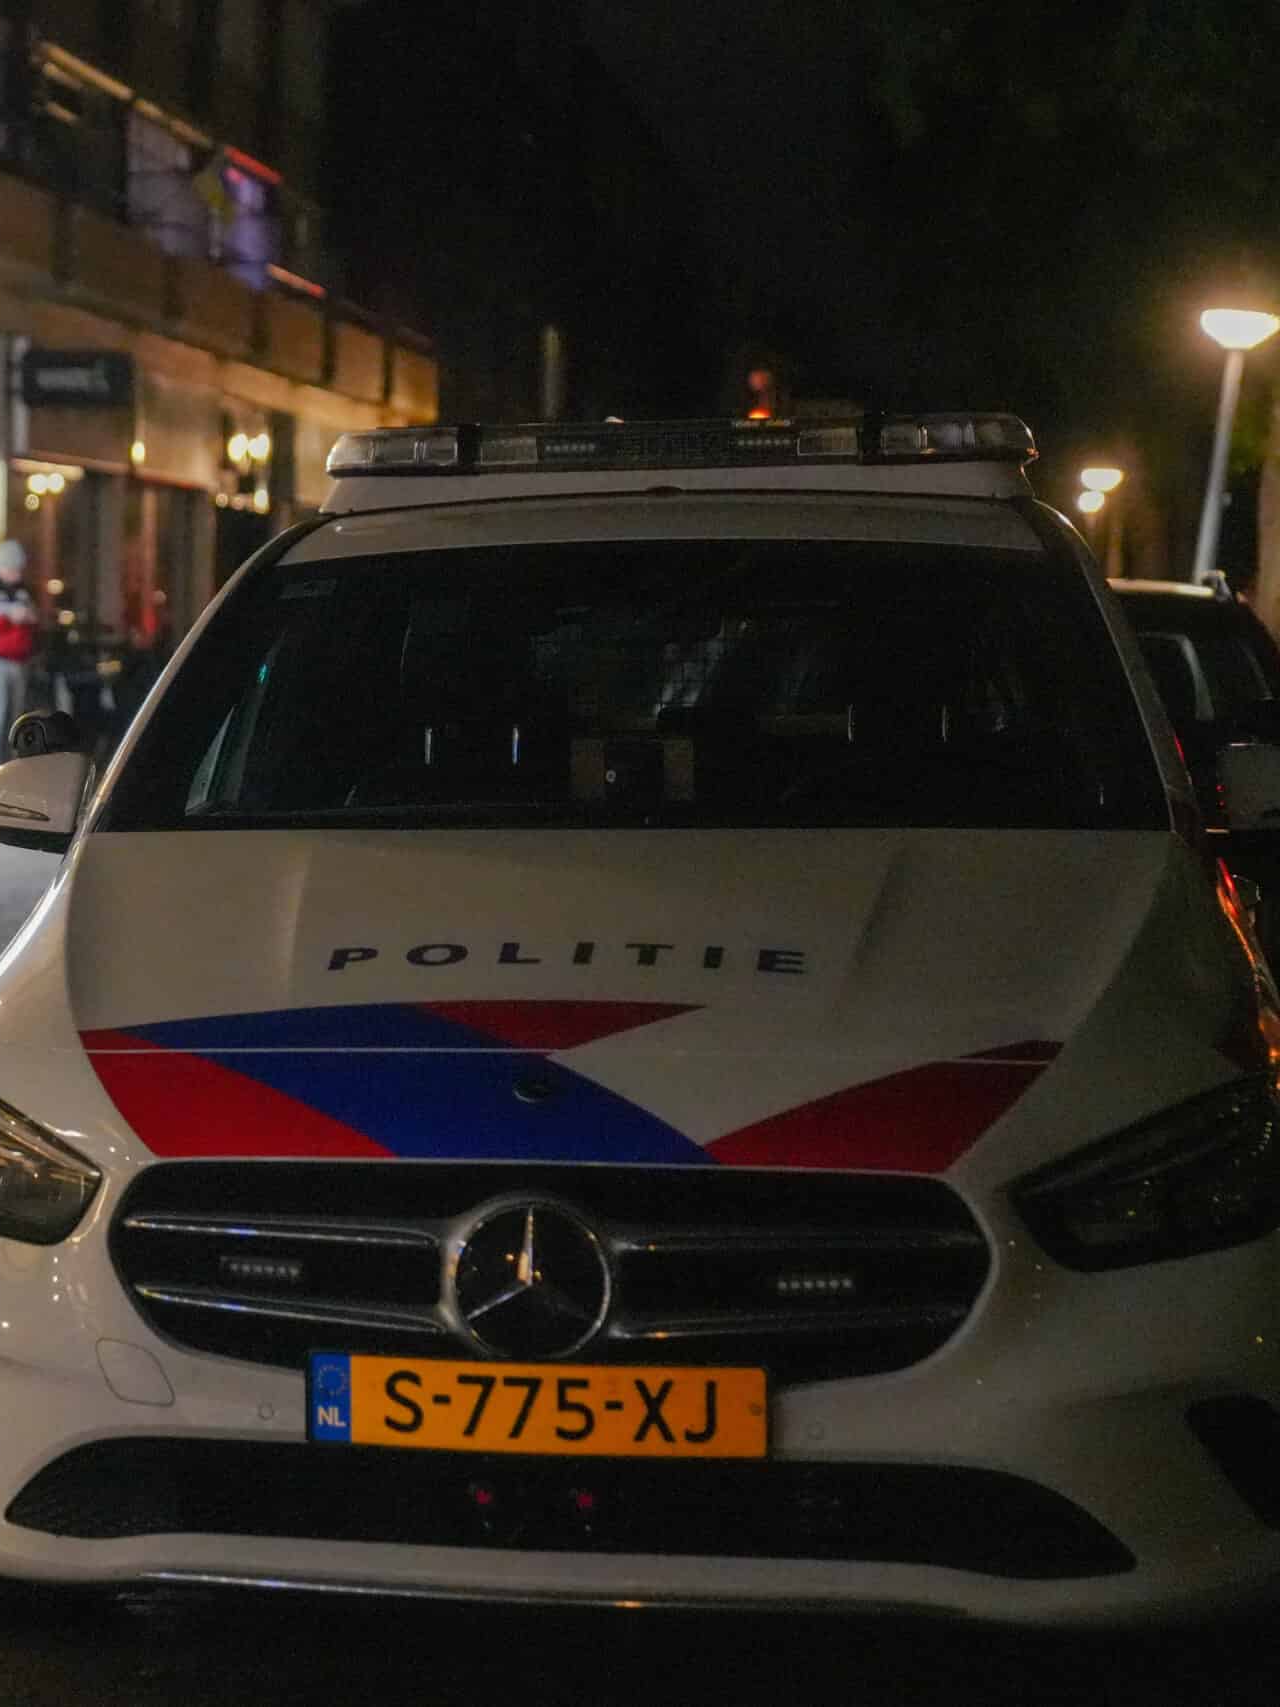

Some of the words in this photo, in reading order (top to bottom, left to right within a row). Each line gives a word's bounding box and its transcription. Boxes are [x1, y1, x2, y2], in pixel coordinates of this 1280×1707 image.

[328, 942, 807, 974] POLITIE
[318, 1406, 347, 1428] NL
[384, 1370, 718, 1444] S-775-XJ
